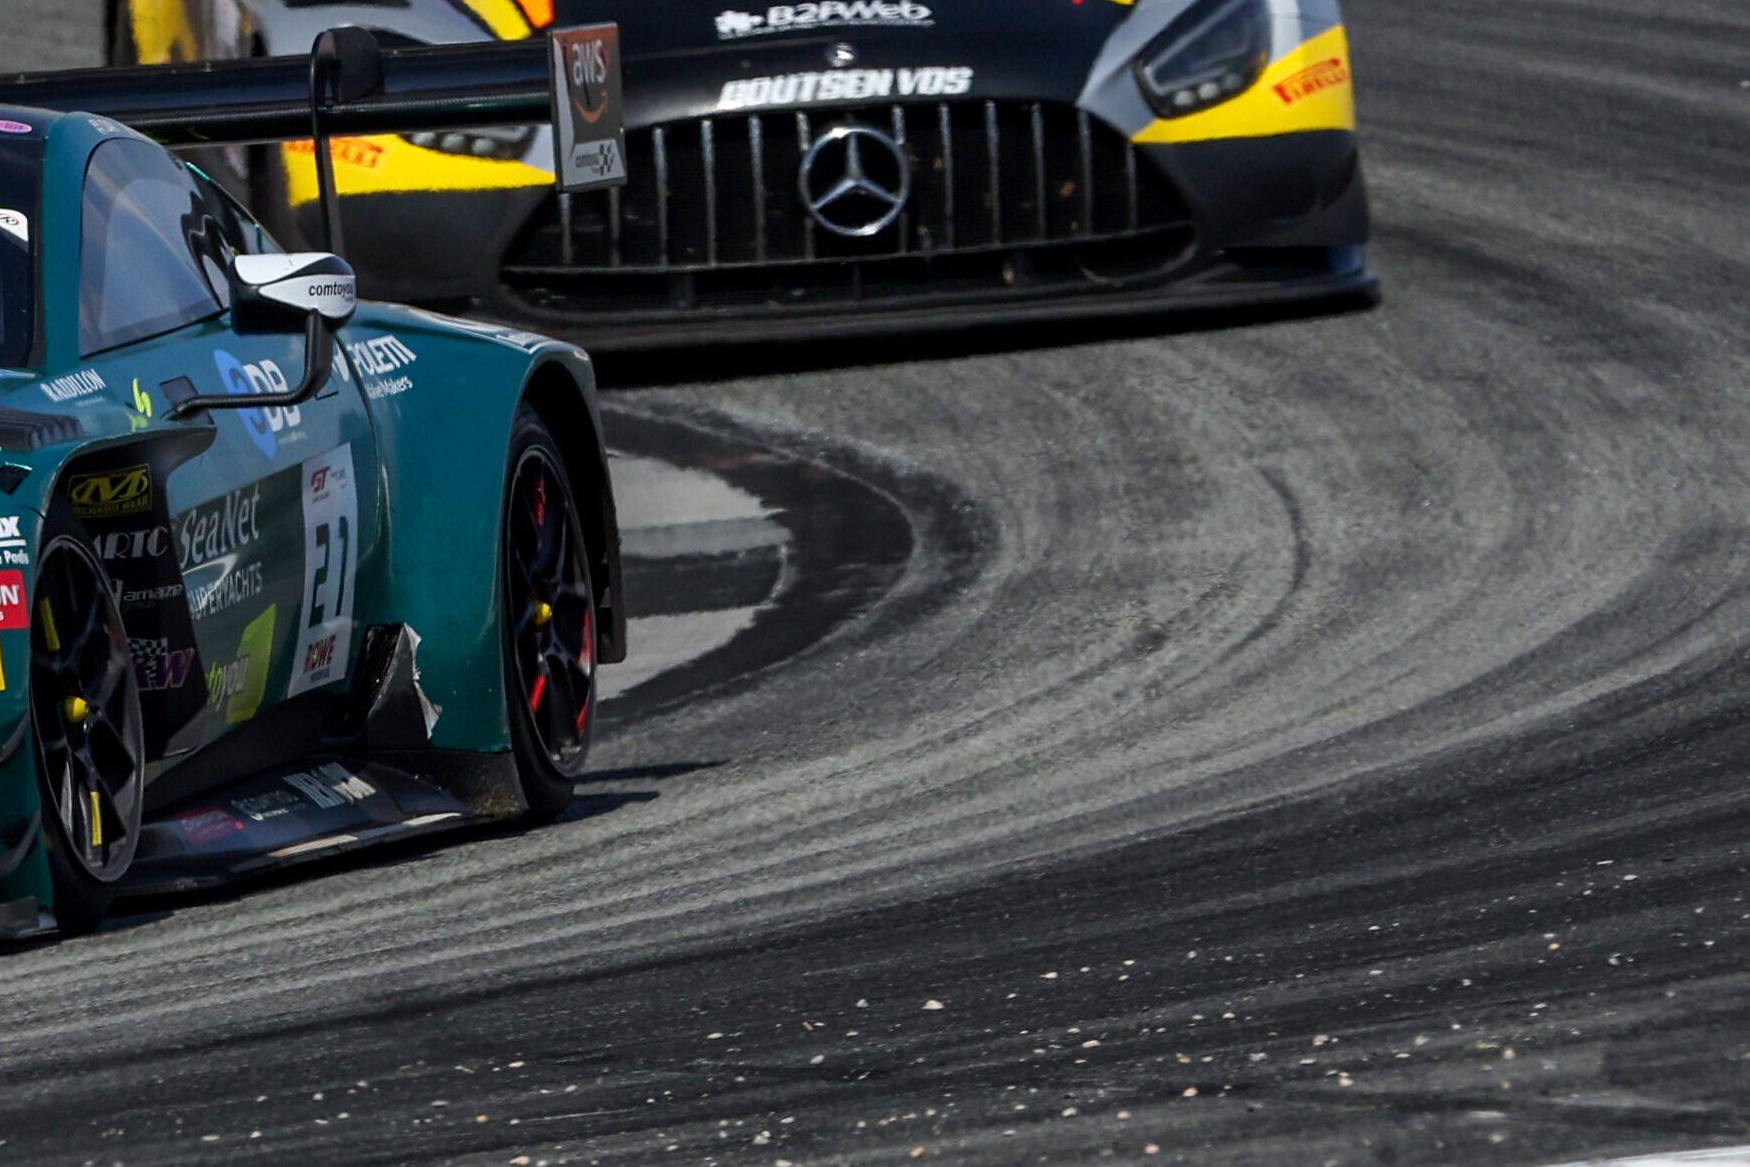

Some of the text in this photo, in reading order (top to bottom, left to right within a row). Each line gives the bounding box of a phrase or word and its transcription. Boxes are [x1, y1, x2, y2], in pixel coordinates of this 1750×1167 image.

[767, 0, 932, 26] B2PWeb
[572, 39, 606, 86] aws
[717, 69, 893, 110] BOUTSEN
[180, 483, 261, 569] SeaNet
[3, 549, 30, 565] Pads
[309, 515, 349, 629] 21
